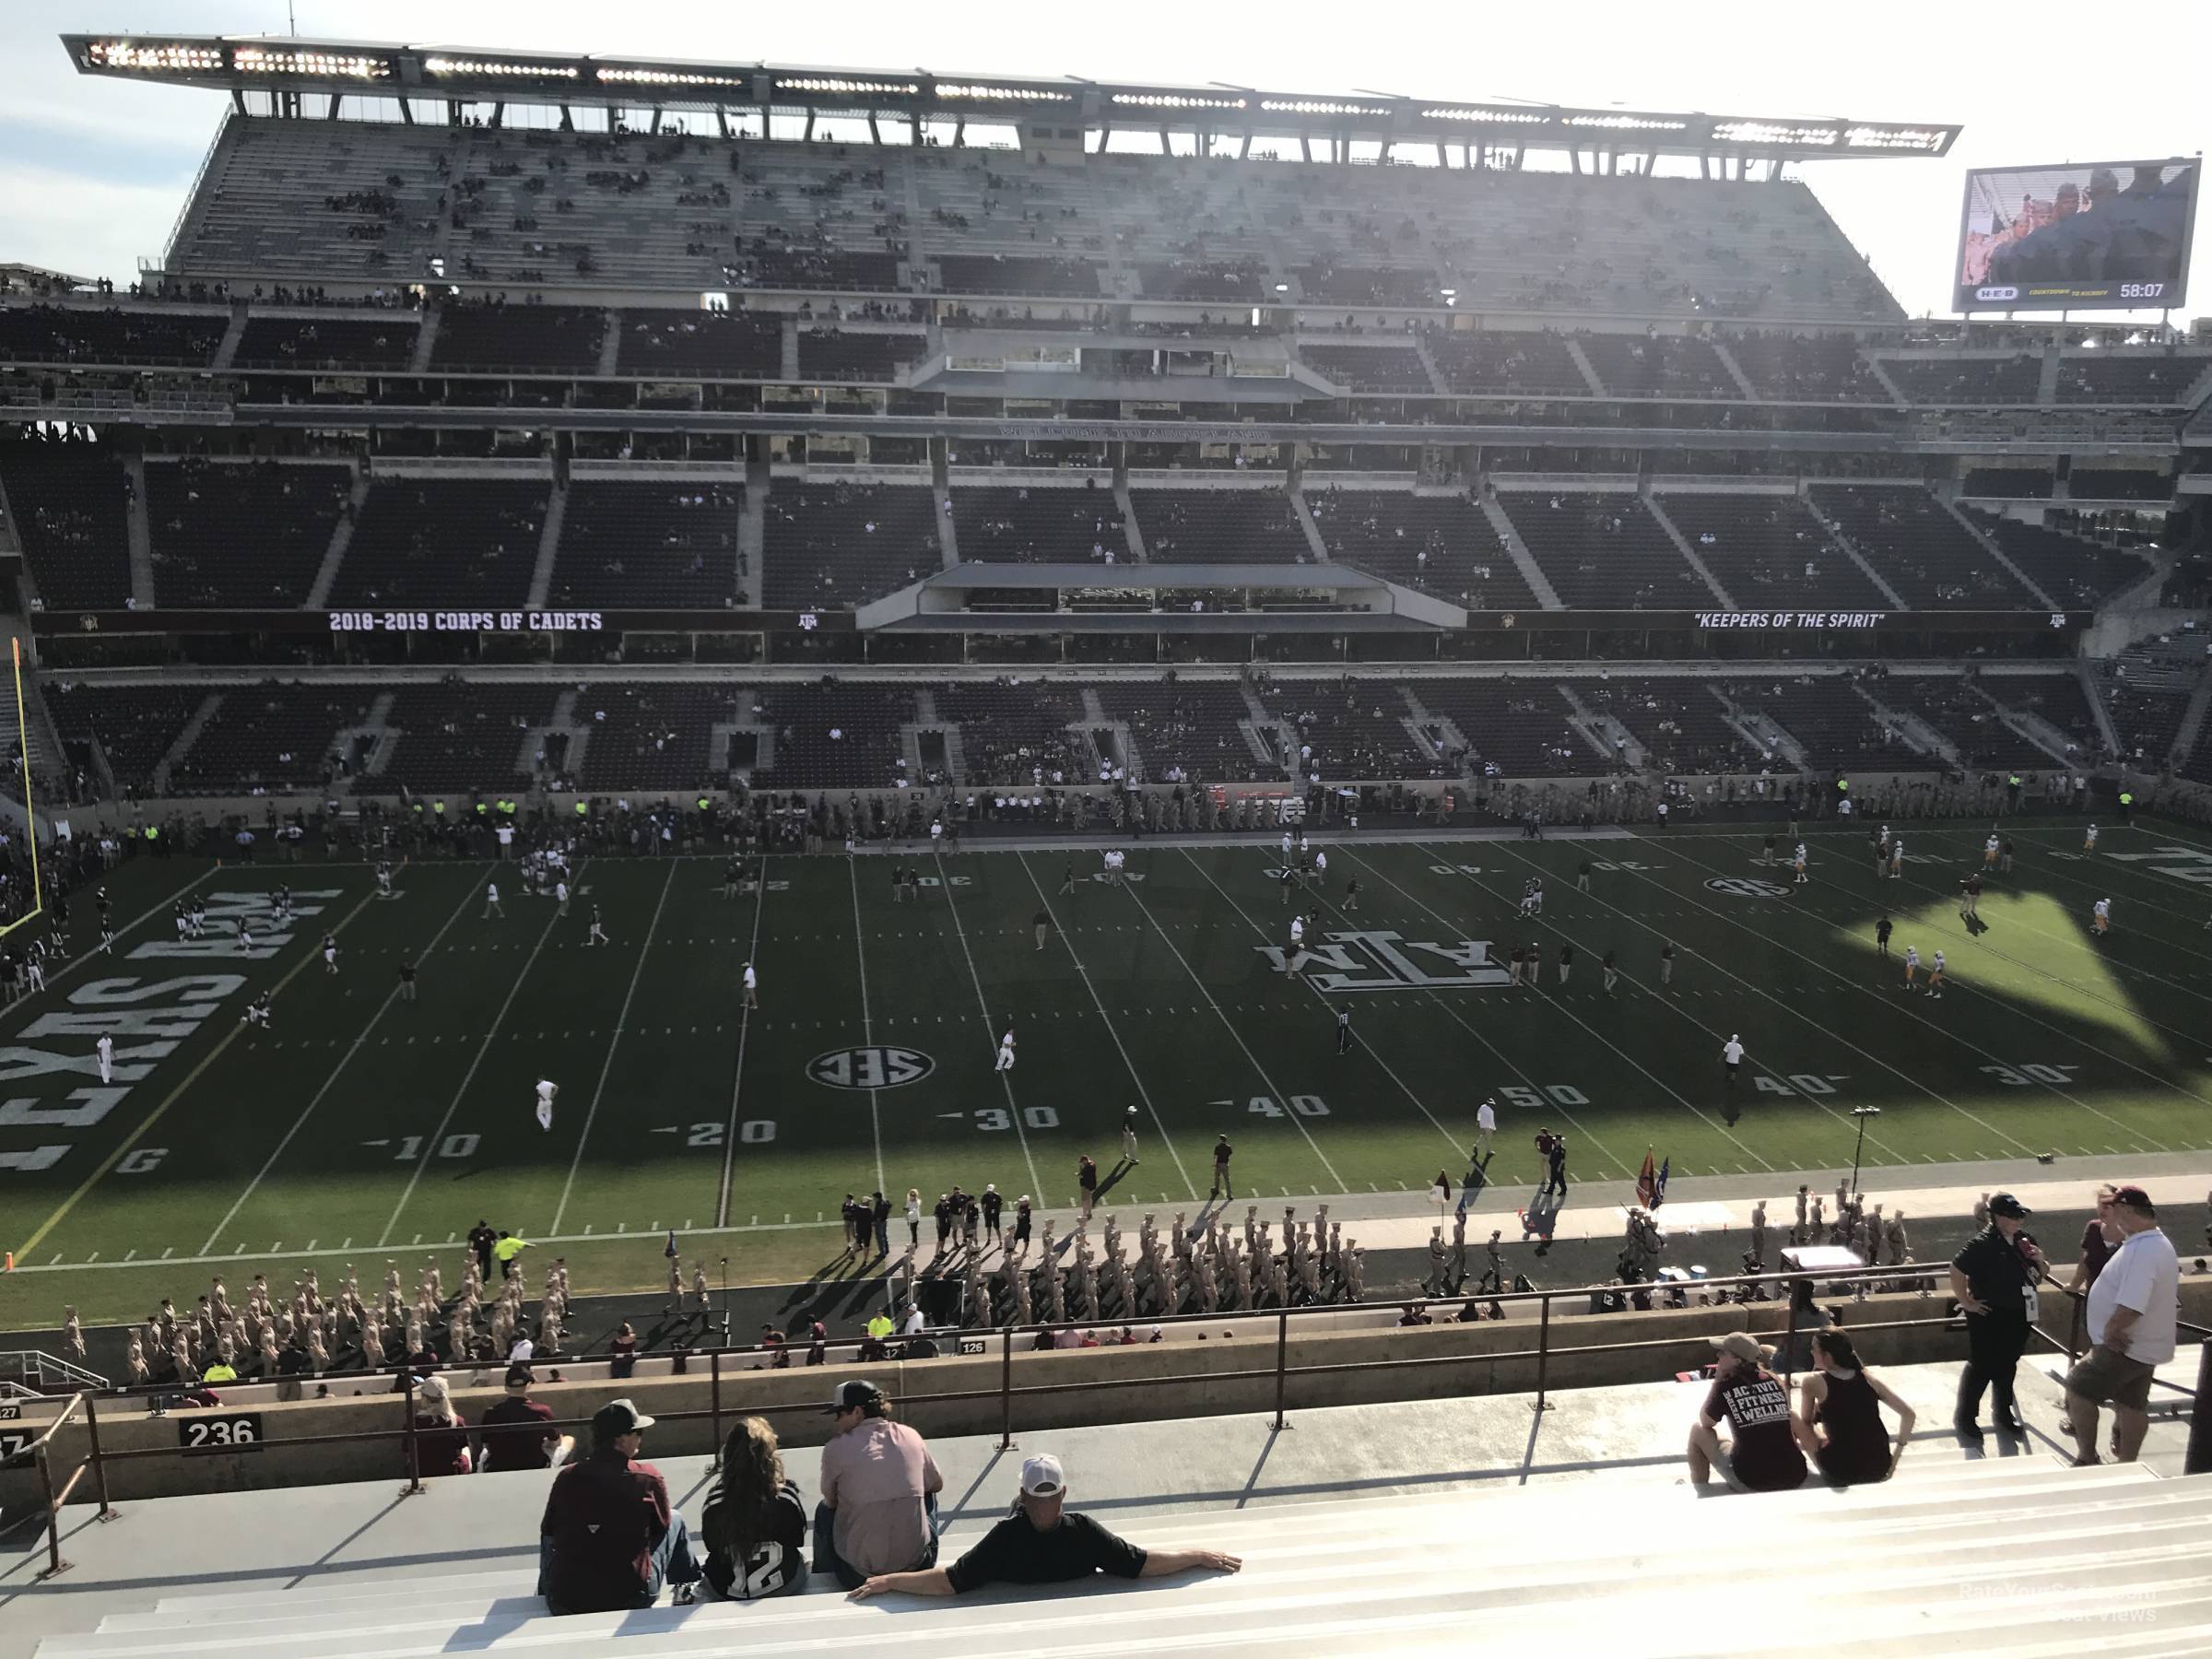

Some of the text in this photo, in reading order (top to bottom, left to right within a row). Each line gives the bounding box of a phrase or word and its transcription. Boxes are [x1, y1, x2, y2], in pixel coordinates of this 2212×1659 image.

[2120, 284, 2164, 298] 58:07
[330, 613, 603, 630] 2018-2019 CORPS OF CADETS
[1694, 613, 1886, 628] "KEEPERS OF THE SPIRIT"
[815, 1049, 924, 1088] SEC
[1978, 1064, 2073, 1086] 30
[1498, 1085, 1591, 1107] 50
[1753, 1074, 1837, 1096] 40
[1248, 1094, 1331, 1118] 40
[973, 1106, 1060, 1131] 30
[687, 1120, 777, 1147] 20
[394, 1134, 481, 1159] 10
[115, 1148, 170, 1173] G
[962, 1343, 982, 1353] 126
[1732, 1380, 1779, 1398] ACIVIT
[1736, 1392, 1786, 1410] FITNESS
[1740, 1403, 1788, 1421] WELLNE
[0, 1407, 17, 1418] 27
[187, 1419, 254, 1447] 236
[726, 1541, 785, 1599] 12
